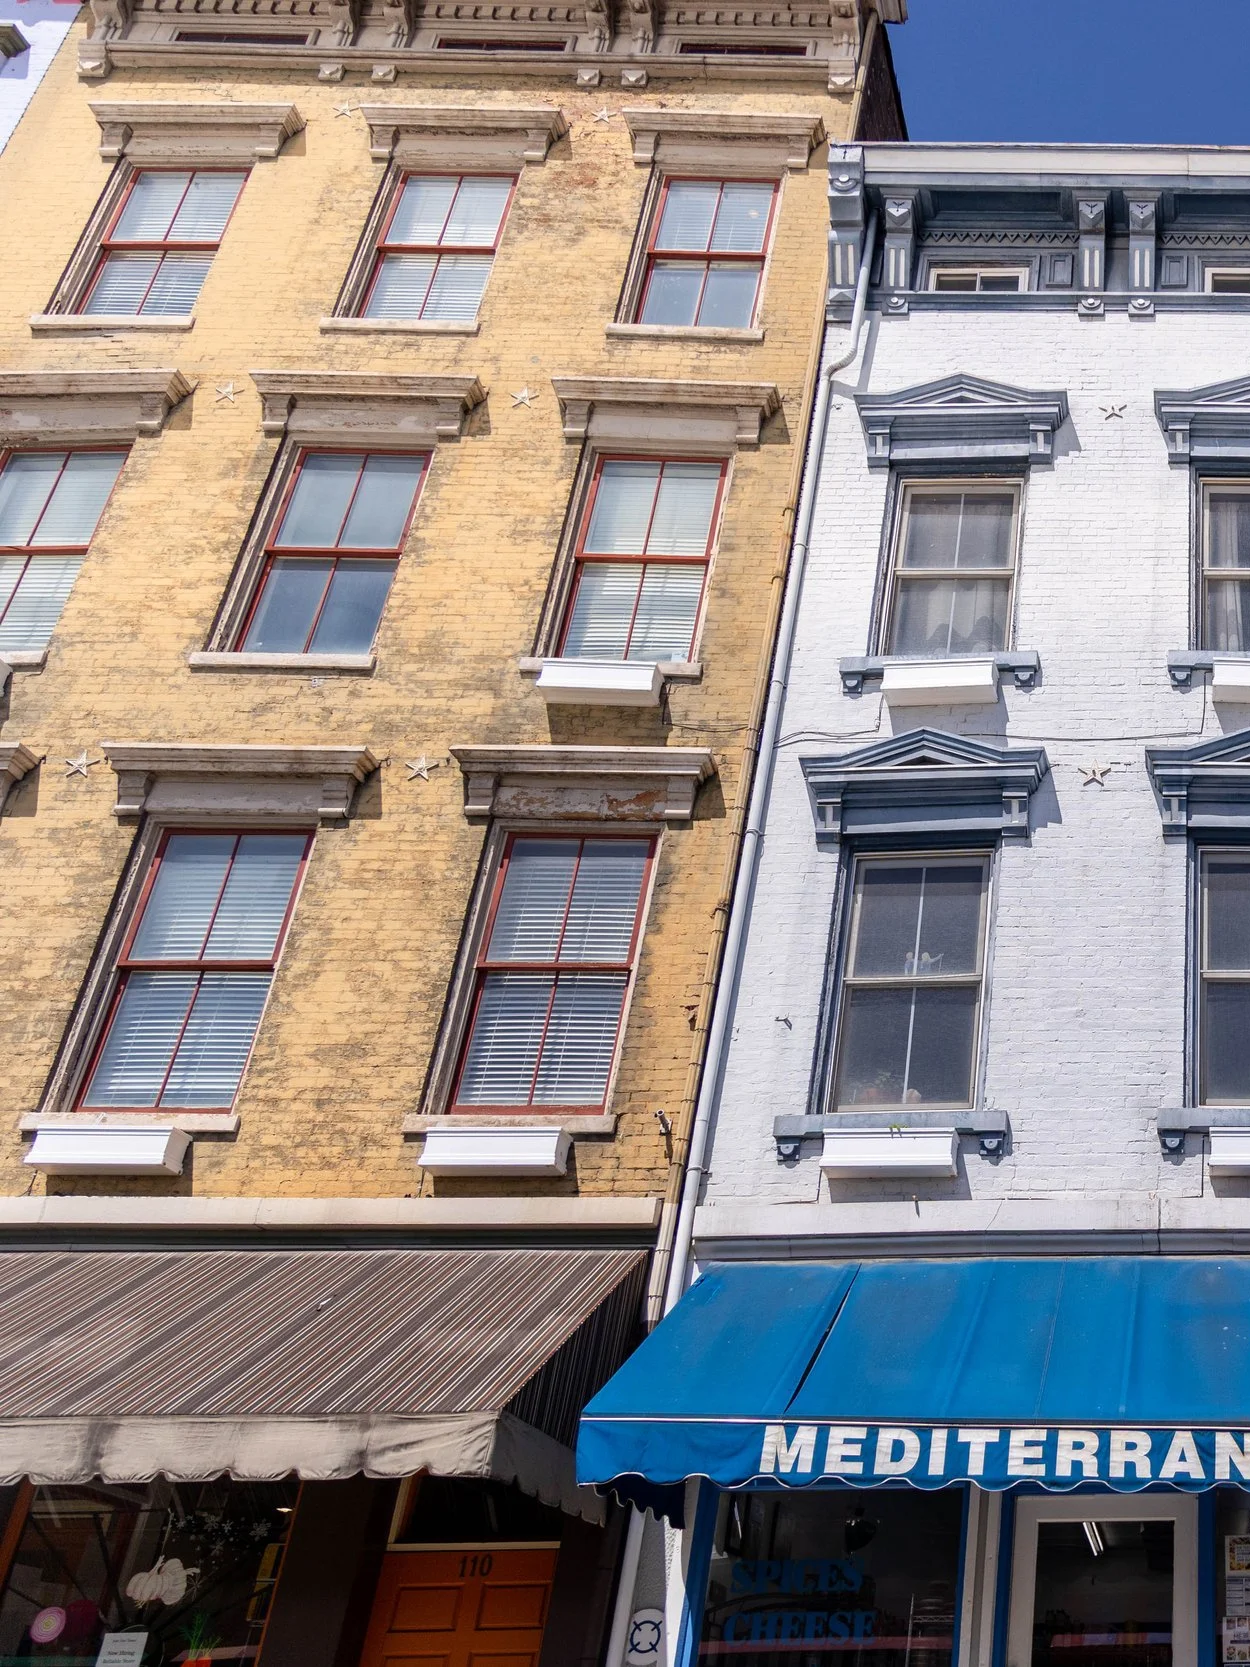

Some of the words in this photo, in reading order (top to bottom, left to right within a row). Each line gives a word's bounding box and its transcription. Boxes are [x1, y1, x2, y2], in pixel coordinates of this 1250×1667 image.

[459, 1554, 493, 1578] 110
[730, 1558, 866, 1593] SPICES
[722, 1610, 879, 1646] CHEESE
